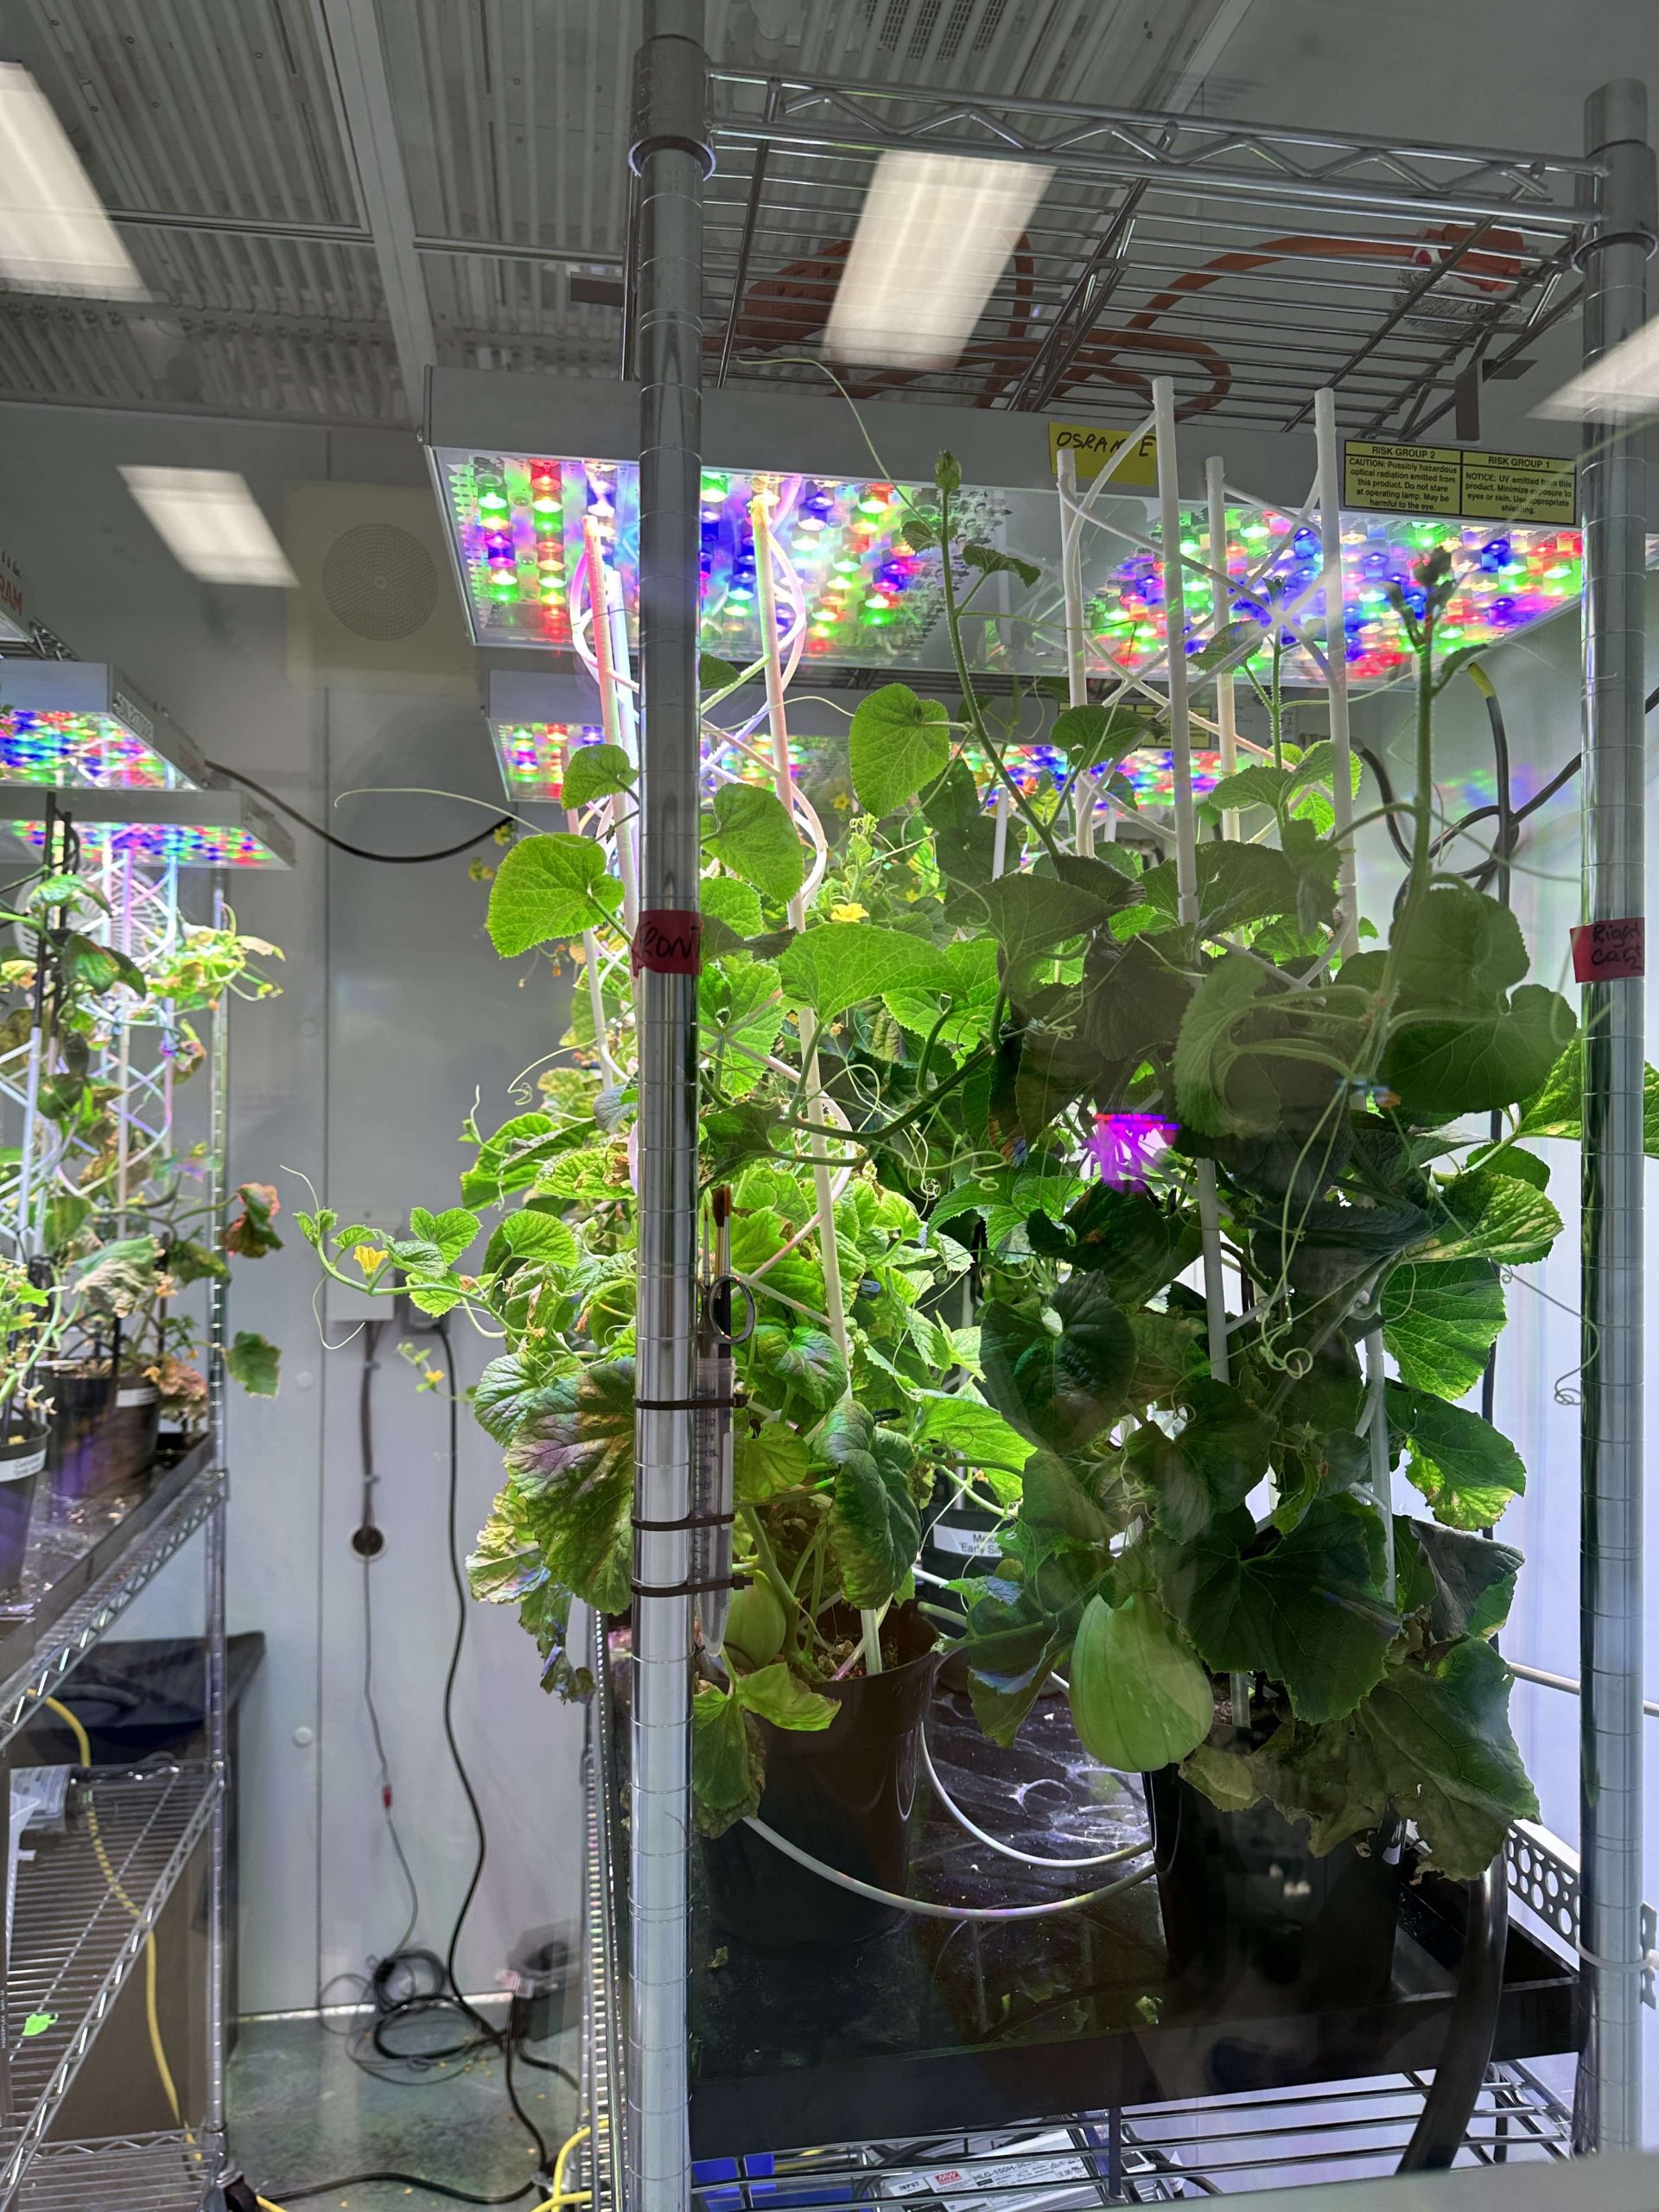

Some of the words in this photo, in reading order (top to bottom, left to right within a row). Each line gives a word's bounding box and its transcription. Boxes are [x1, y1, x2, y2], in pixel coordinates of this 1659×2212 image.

[1372, 446, 1394, 455] RISK
[1395, 448, 1427, 458] GROUP
[1349, 458, 1386, 467] CAUTION:
[1388, 461, 1417, 472] Possibly
[1419, 464, 1457, 474] hazardous
[1488, 455, 1510, 466] RISK
[1511, 458, 1542, 467] GROUP
[1351, 468, 1376, 477] optical
[1376, 470, 1408, 480] radiation
[1410, 474, 1438, 482] emitted
[1439, 474, 1456, 483] from
[1465, 472, 1497, 482] NOTICE:
[1499, 474, 1510, 483] UV
[1512, 477, 1539, 486] emitted
[1559, 480, 1572, 488] this
[1357, 478, 1371, 486] this
[1373, 480, 1402, 489] product.
[1404, 481, 1415, 490] Do
[1465, 483, 1496, 492] product.
[1497, 484, 1529, 494] Minimize
[1530, 487, 1563, 497] eposure
[1365, 489, 1400, 499] operating
[1402, 491, 1421, 500] lamp.
[1423, 493, 1439, 502] May
[1467, 493, 1484, 501] eyes
[1370, 498, 1397, 508] harmful
[1421, 503, 1436, 512] eye.
